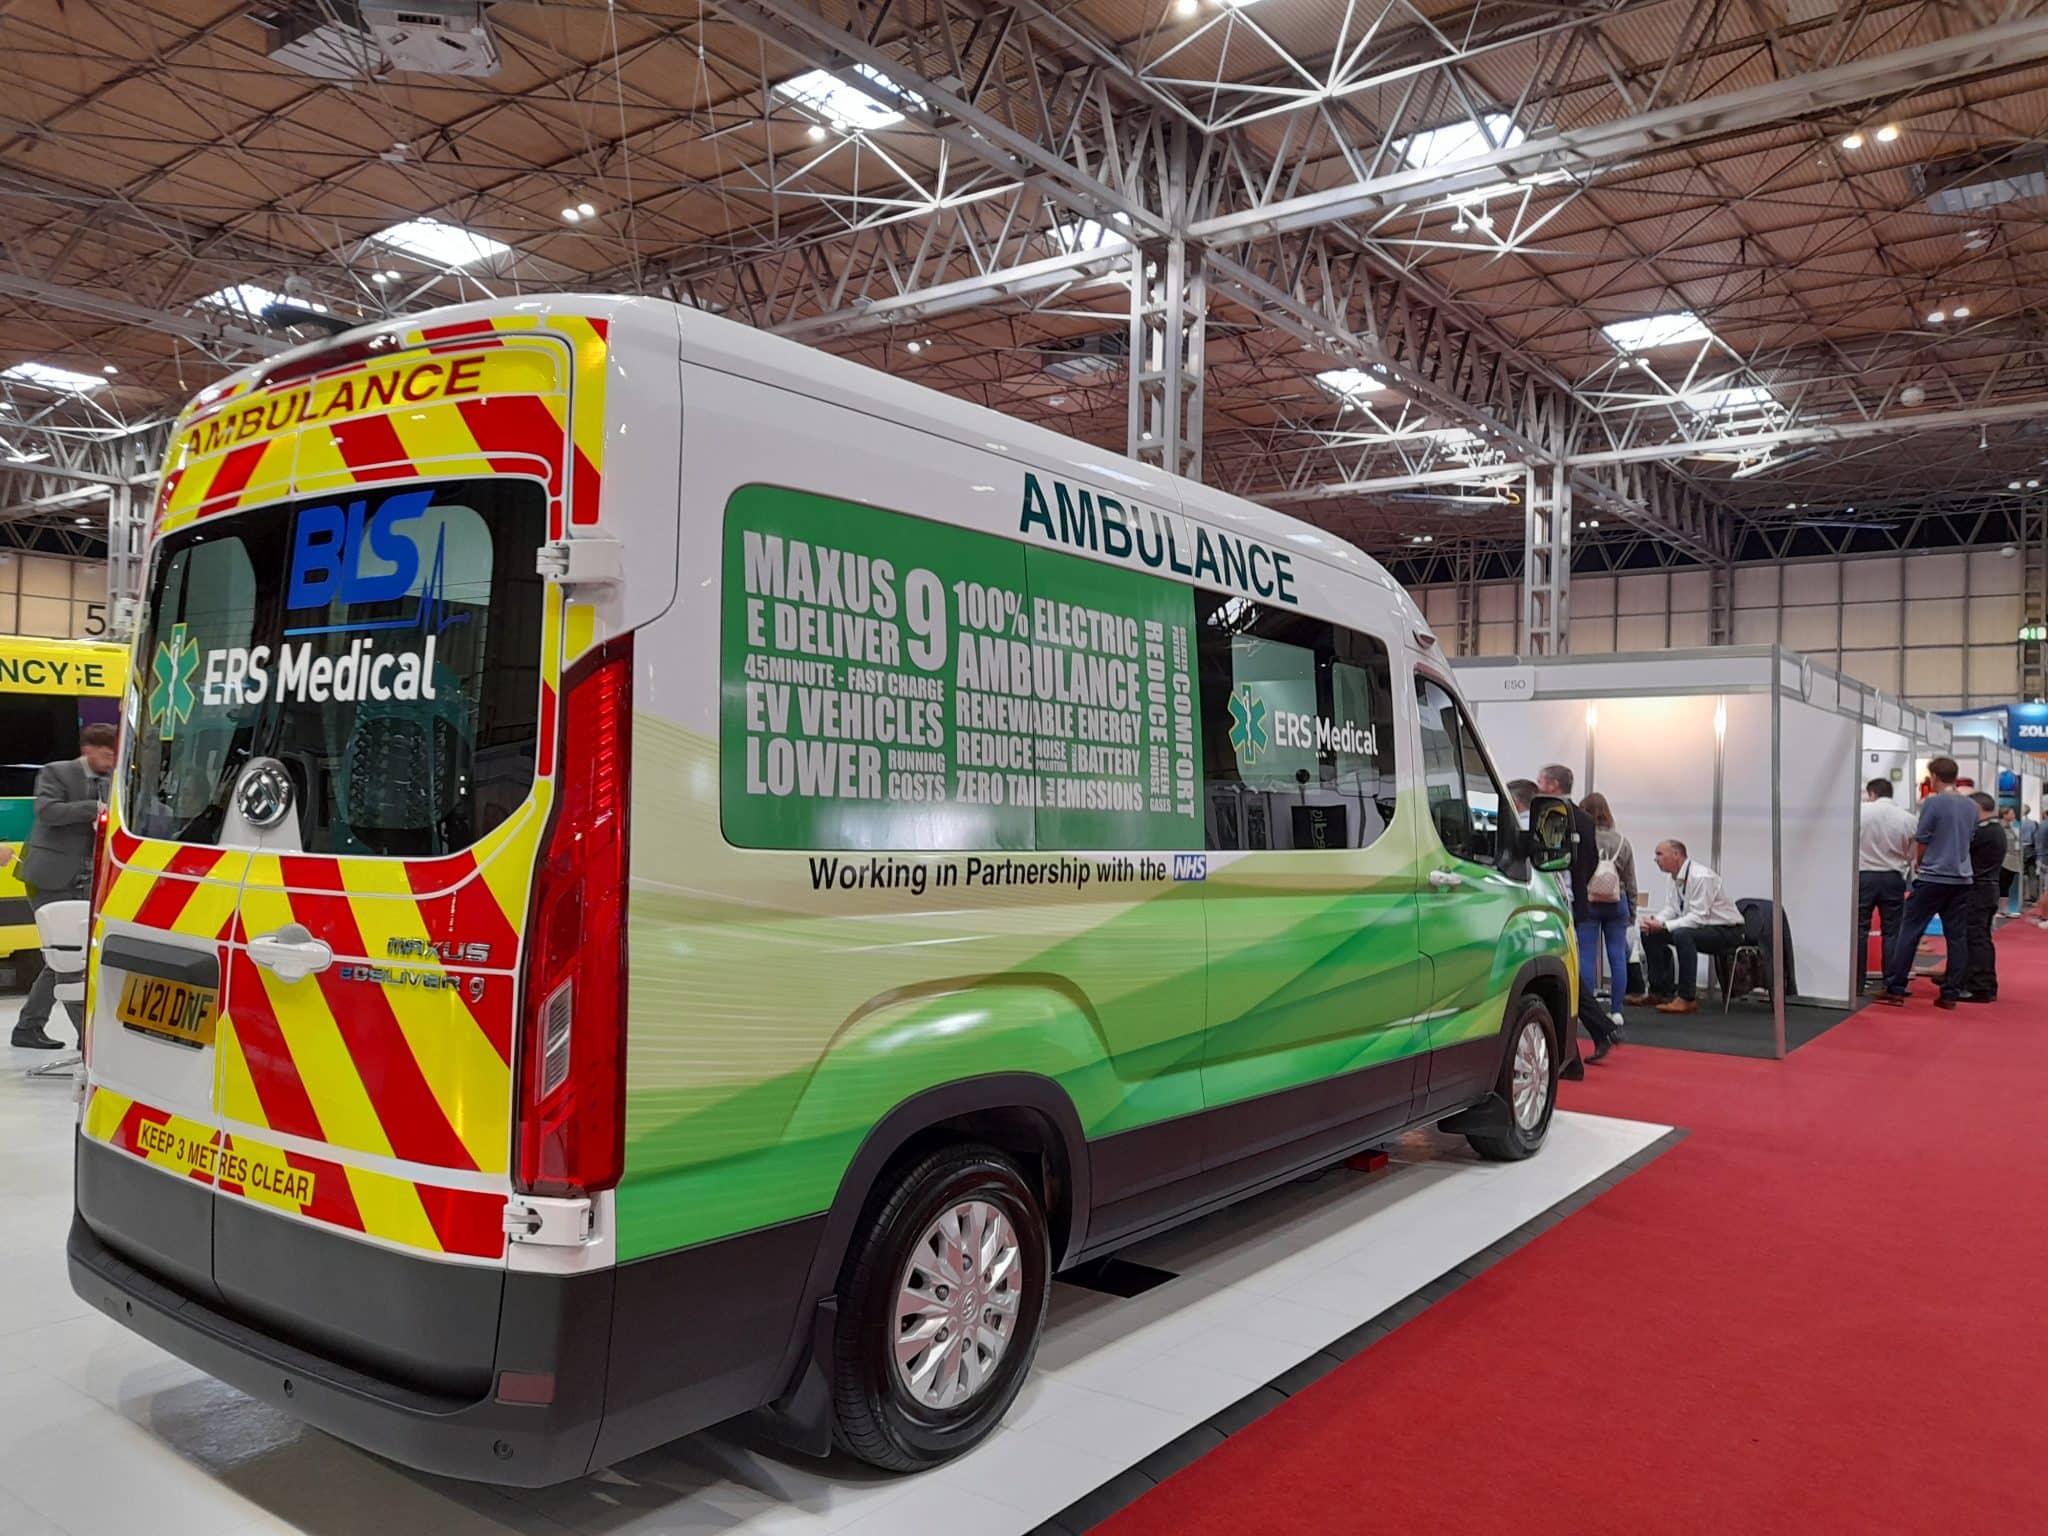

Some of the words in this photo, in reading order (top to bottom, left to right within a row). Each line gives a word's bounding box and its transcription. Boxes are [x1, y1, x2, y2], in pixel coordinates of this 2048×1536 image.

[186, 356, 485, 455] AMBULANCE
[1019, 472, 1298, 604] AMBULANCE
[84, 604, 106, 635] 5
[743, 530, 897, 619] MAXUS
[905, 568, 947, 671] 9
[952, 580, 1029, 638] 100%
[1033, 597, 1139, 659] ELECTRIC
[747, 597, 766, 647] E
[774, 602, 900, 667] DELIVER
[203, 645, 270, 705] ERS
[276, 634, 436, 703] Medical
[744, 654, 834, 688] 45MINUTE
[848, 667, 885, 694] FAST
[888, 672, 944, 701] CHARGE
[956, 631, 1141, 712] AMBULANCE
[1145, 620, 1168, 743] REDUCE
[746, 681, 790, 733] EV
[798, 687, 944, 748] VEHICLES
[956, 690, 1074, 738] RENEWABLE
[1078, 706, 1141, 745] ENERGY
[1275, 710, 1312, 749] ERS
[1315, 716, 1378, 756] Medical
[746, 736, 881, 799] LOWER
[888, 749, 945, 773] RUNNING
[956, 731, 1033, 770] REDUCE
[1035, 738, 1066, 760] NOISE
[1078, 744, 1141, 776] BATTERY
[1173, 672, 1194, 818] COMFORT
[888, 772, 945, 801] COSTS
[956, 770, 1003, 805] ZERO
[1006, 774, 1045, 807] TAIL
[1057, 777, 1143, 812] EMISSIONS
[809, 857, 927, 895] Working
[936, 858, 957, 886] in
[966, 857, 1090, 890] Partnership
[1097, 857, 1134, 881] with
[1140, 857, 1166, 881] the
[1174, 856, 1206, 880] NHS
[387, 937, 490, 962] MAXUS
[168, 988, 213, 1032] DNF
[469, 977, 485, 1003] 9
[141, 1124, 174, 1155] KEEP
[176, 1139, 185, 1160] 3
[187, 1142, 247, 1185] METRES
[252, 1163, 309, 1201] CLEAR
